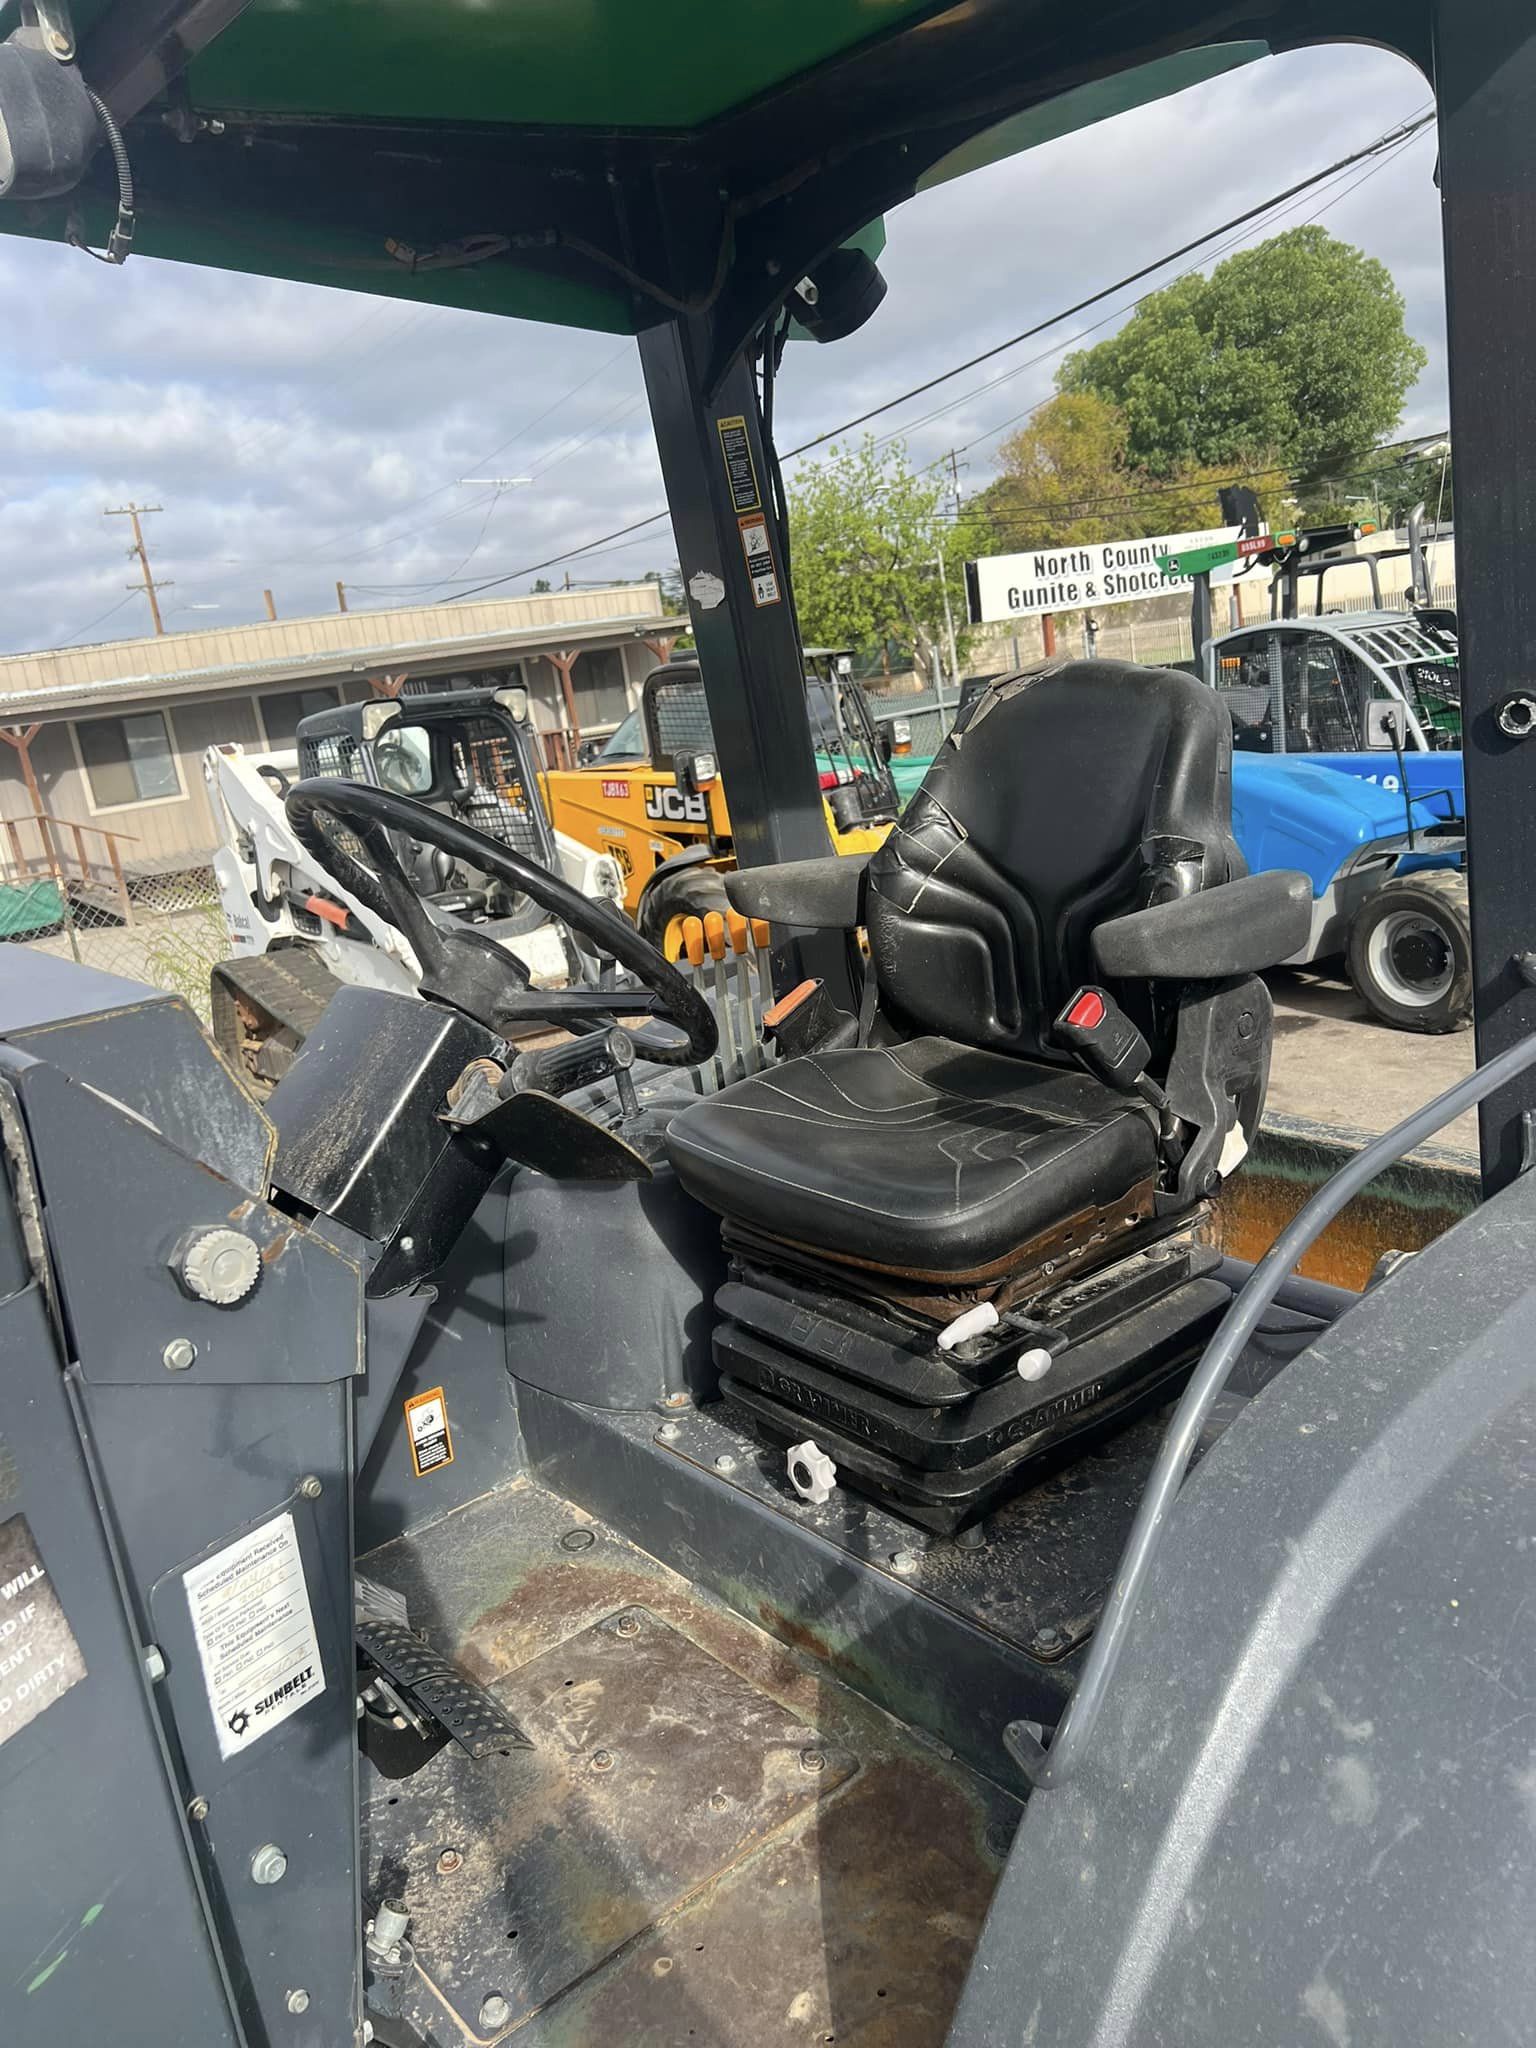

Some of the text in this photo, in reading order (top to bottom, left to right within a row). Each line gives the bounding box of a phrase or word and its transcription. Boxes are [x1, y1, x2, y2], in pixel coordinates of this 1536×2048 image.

[1034, 551, 1091, 577] North
[1007, 582, 1078, 609] Gunite
[1086, 581, 1097, 598] &
[647, 786, 707, 821] JCB
[253, 1532, 284, 1556] Received
[0, 1564, 45, 1600] WILL
[196, 1571, 234, 1600] Scheduled
[234, 1545, 277, 1576] Maintenance
[277, 1537, 289, 1549] On
[19, 1602, 37, 1623] IF
[15, 1651, 66, 1700] DIRTY
[253, 1665, 314, 1716] SUNBELT
